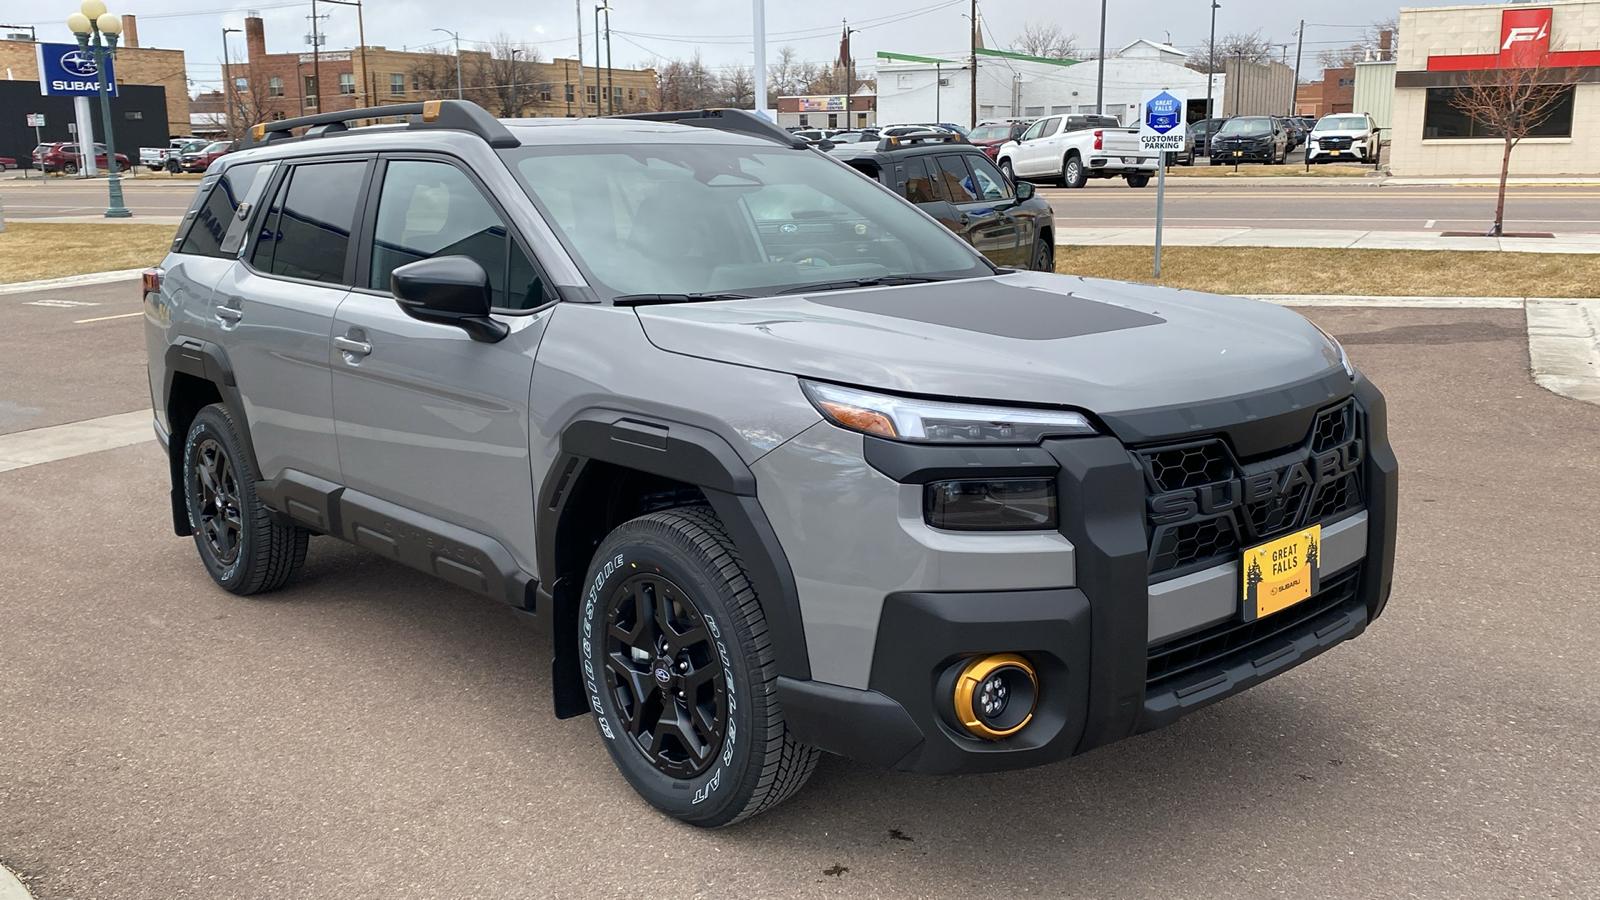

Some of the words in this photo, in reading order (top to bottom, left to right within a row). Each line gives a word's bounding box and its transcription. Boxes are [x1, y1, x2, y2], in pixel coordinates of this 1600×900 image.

[1151, 438, 1363, 525] SUBARU
[1272, 543, 1298, 562] GREAT
[1272, 556, 1298, 576] FALLS
[1278, 579, 1301, 593] SUBARU
[582, 553, 624, 740] BRIDGESTONE
[704, 614, 737, 767] DUELER
[692, 767, 721, 805] A/T
